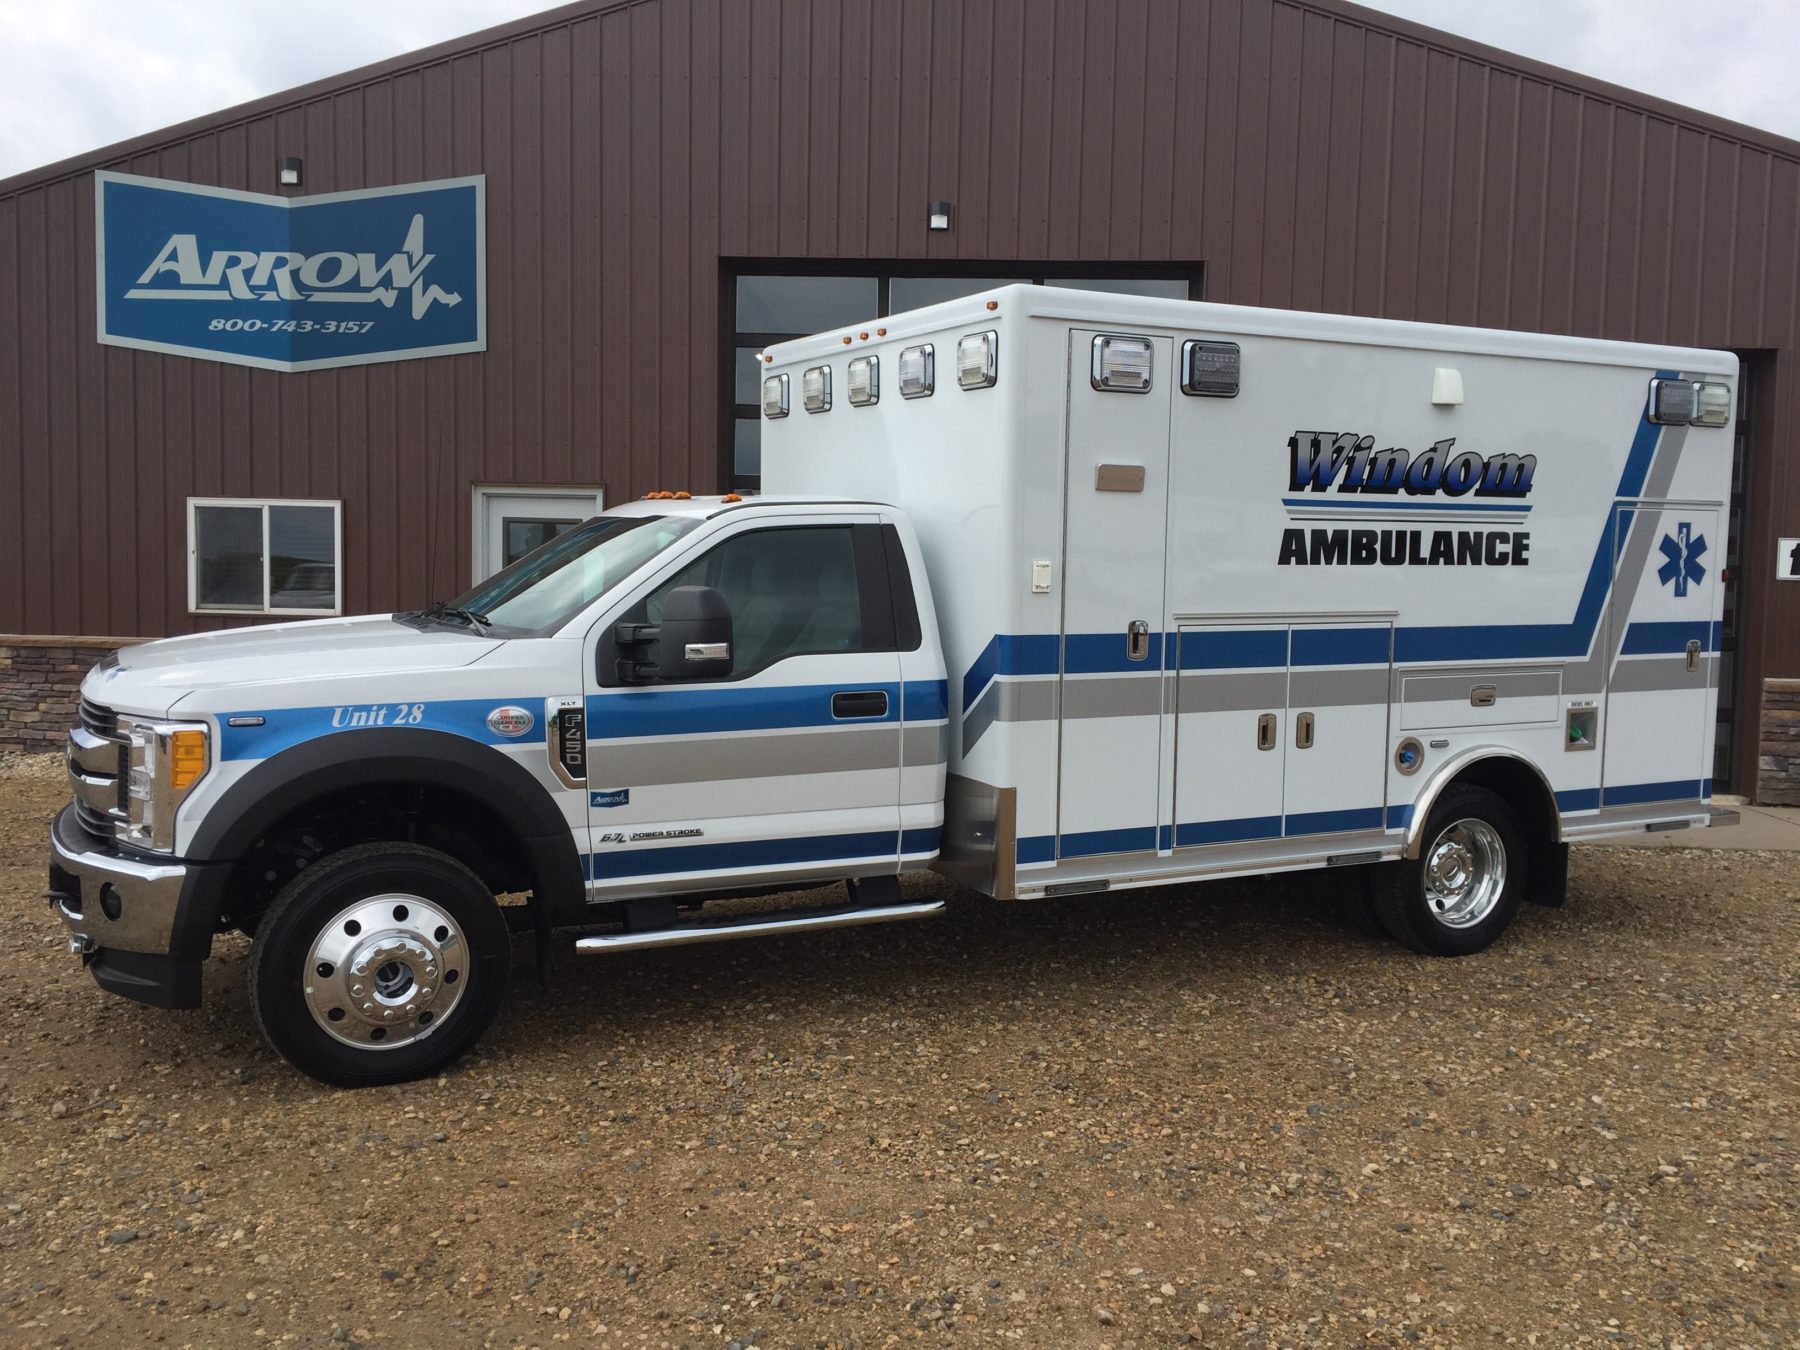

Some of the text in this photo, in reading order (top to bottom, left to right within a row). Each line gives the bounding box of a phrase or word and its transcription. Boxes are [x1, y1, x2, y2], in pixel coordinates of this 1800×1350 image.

[136, 233, 437, 300] ARROW
[208, 318, 375, 333] 800-743-3157
[1288, 430, 1537, 498] Windom
[1277, 528, 1530, 566] AMBULANCE
[331, 704, 425, 727] Unit 28
[600, 833, 626, 843] 6.7L
[632, 828, 702, 839] POWER STROKE
